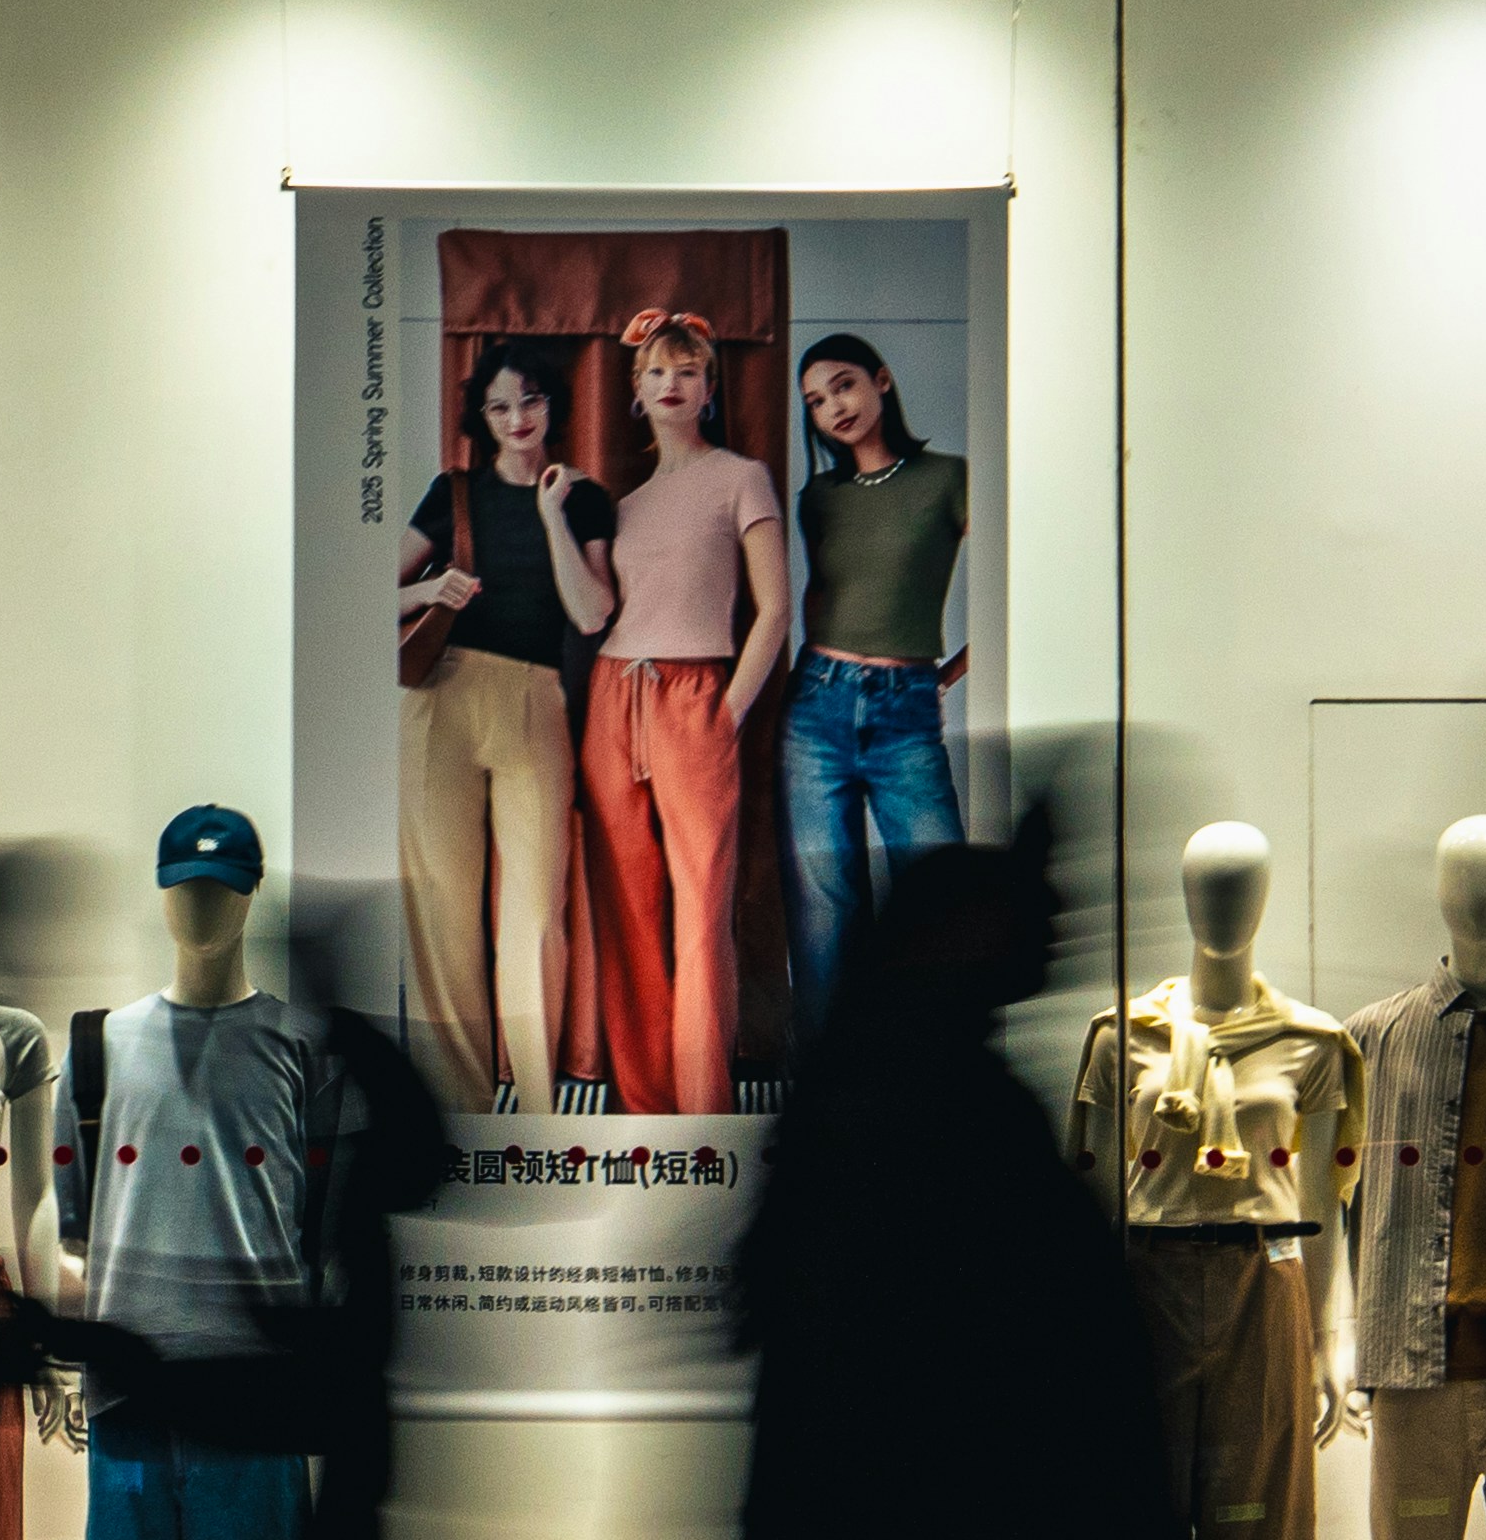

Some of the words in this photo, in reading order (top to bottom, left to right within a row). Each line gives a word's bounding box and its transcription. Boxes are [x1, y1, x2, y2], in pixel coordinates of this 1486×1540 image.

[362, 216, 384, 309] Collection
[362, 316, 384, 400] Summer
[362, 407, 388, 468] Spring
[362, 476, 383, 524] 2025
